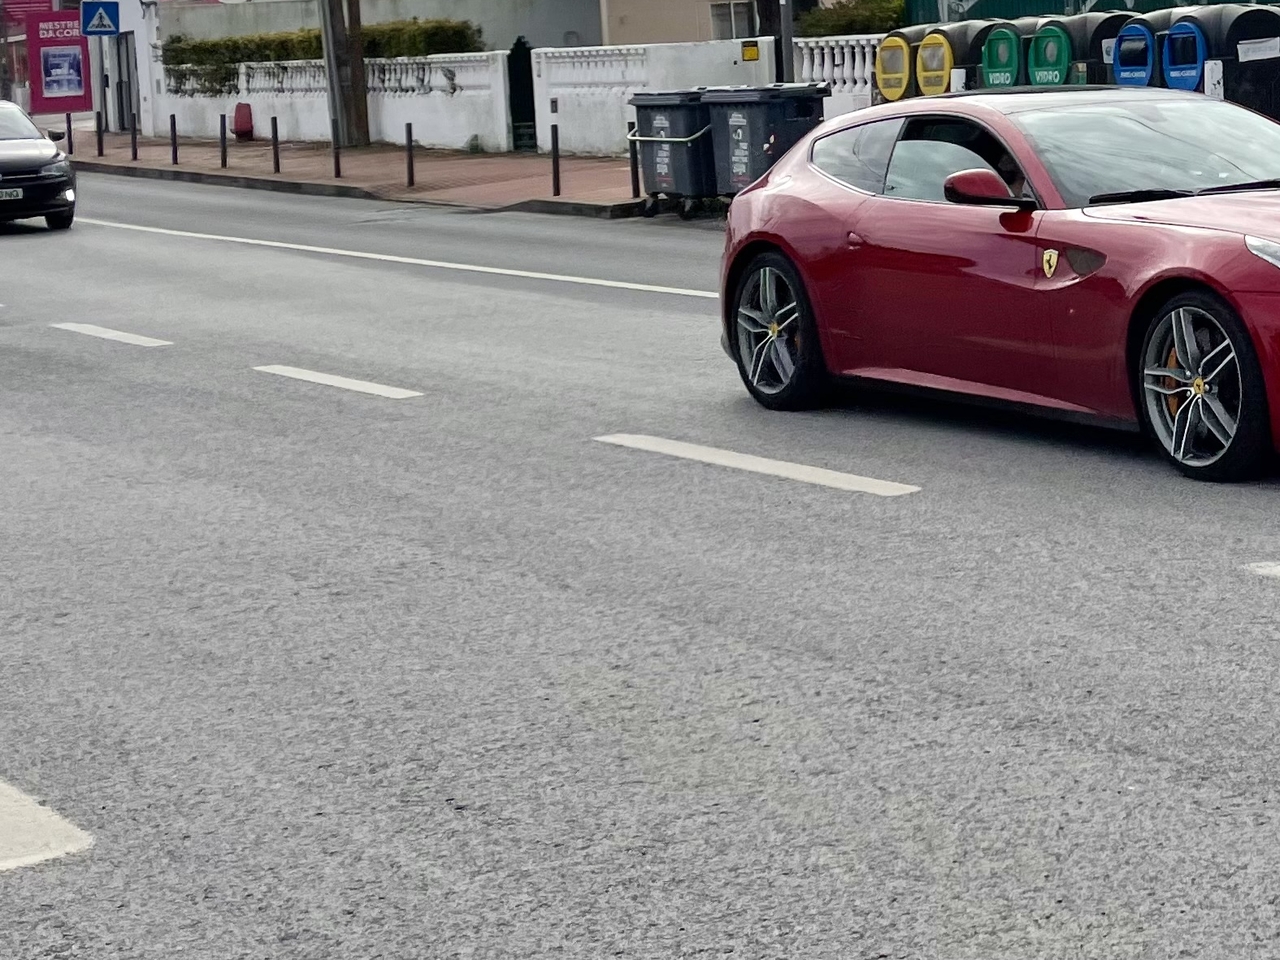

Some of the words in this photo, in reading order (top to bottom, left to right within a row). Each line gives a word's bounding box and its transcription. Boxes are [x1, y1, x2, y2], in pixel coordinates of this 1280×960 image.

[38, 21, 80, 29] MESTRE
[38, 29, 56, 39] DA
[56, 28, 80, 38] COR
[988, 72, 1011, 85] VIDRO
[1035, 70, 1060, 84] VIDRO
